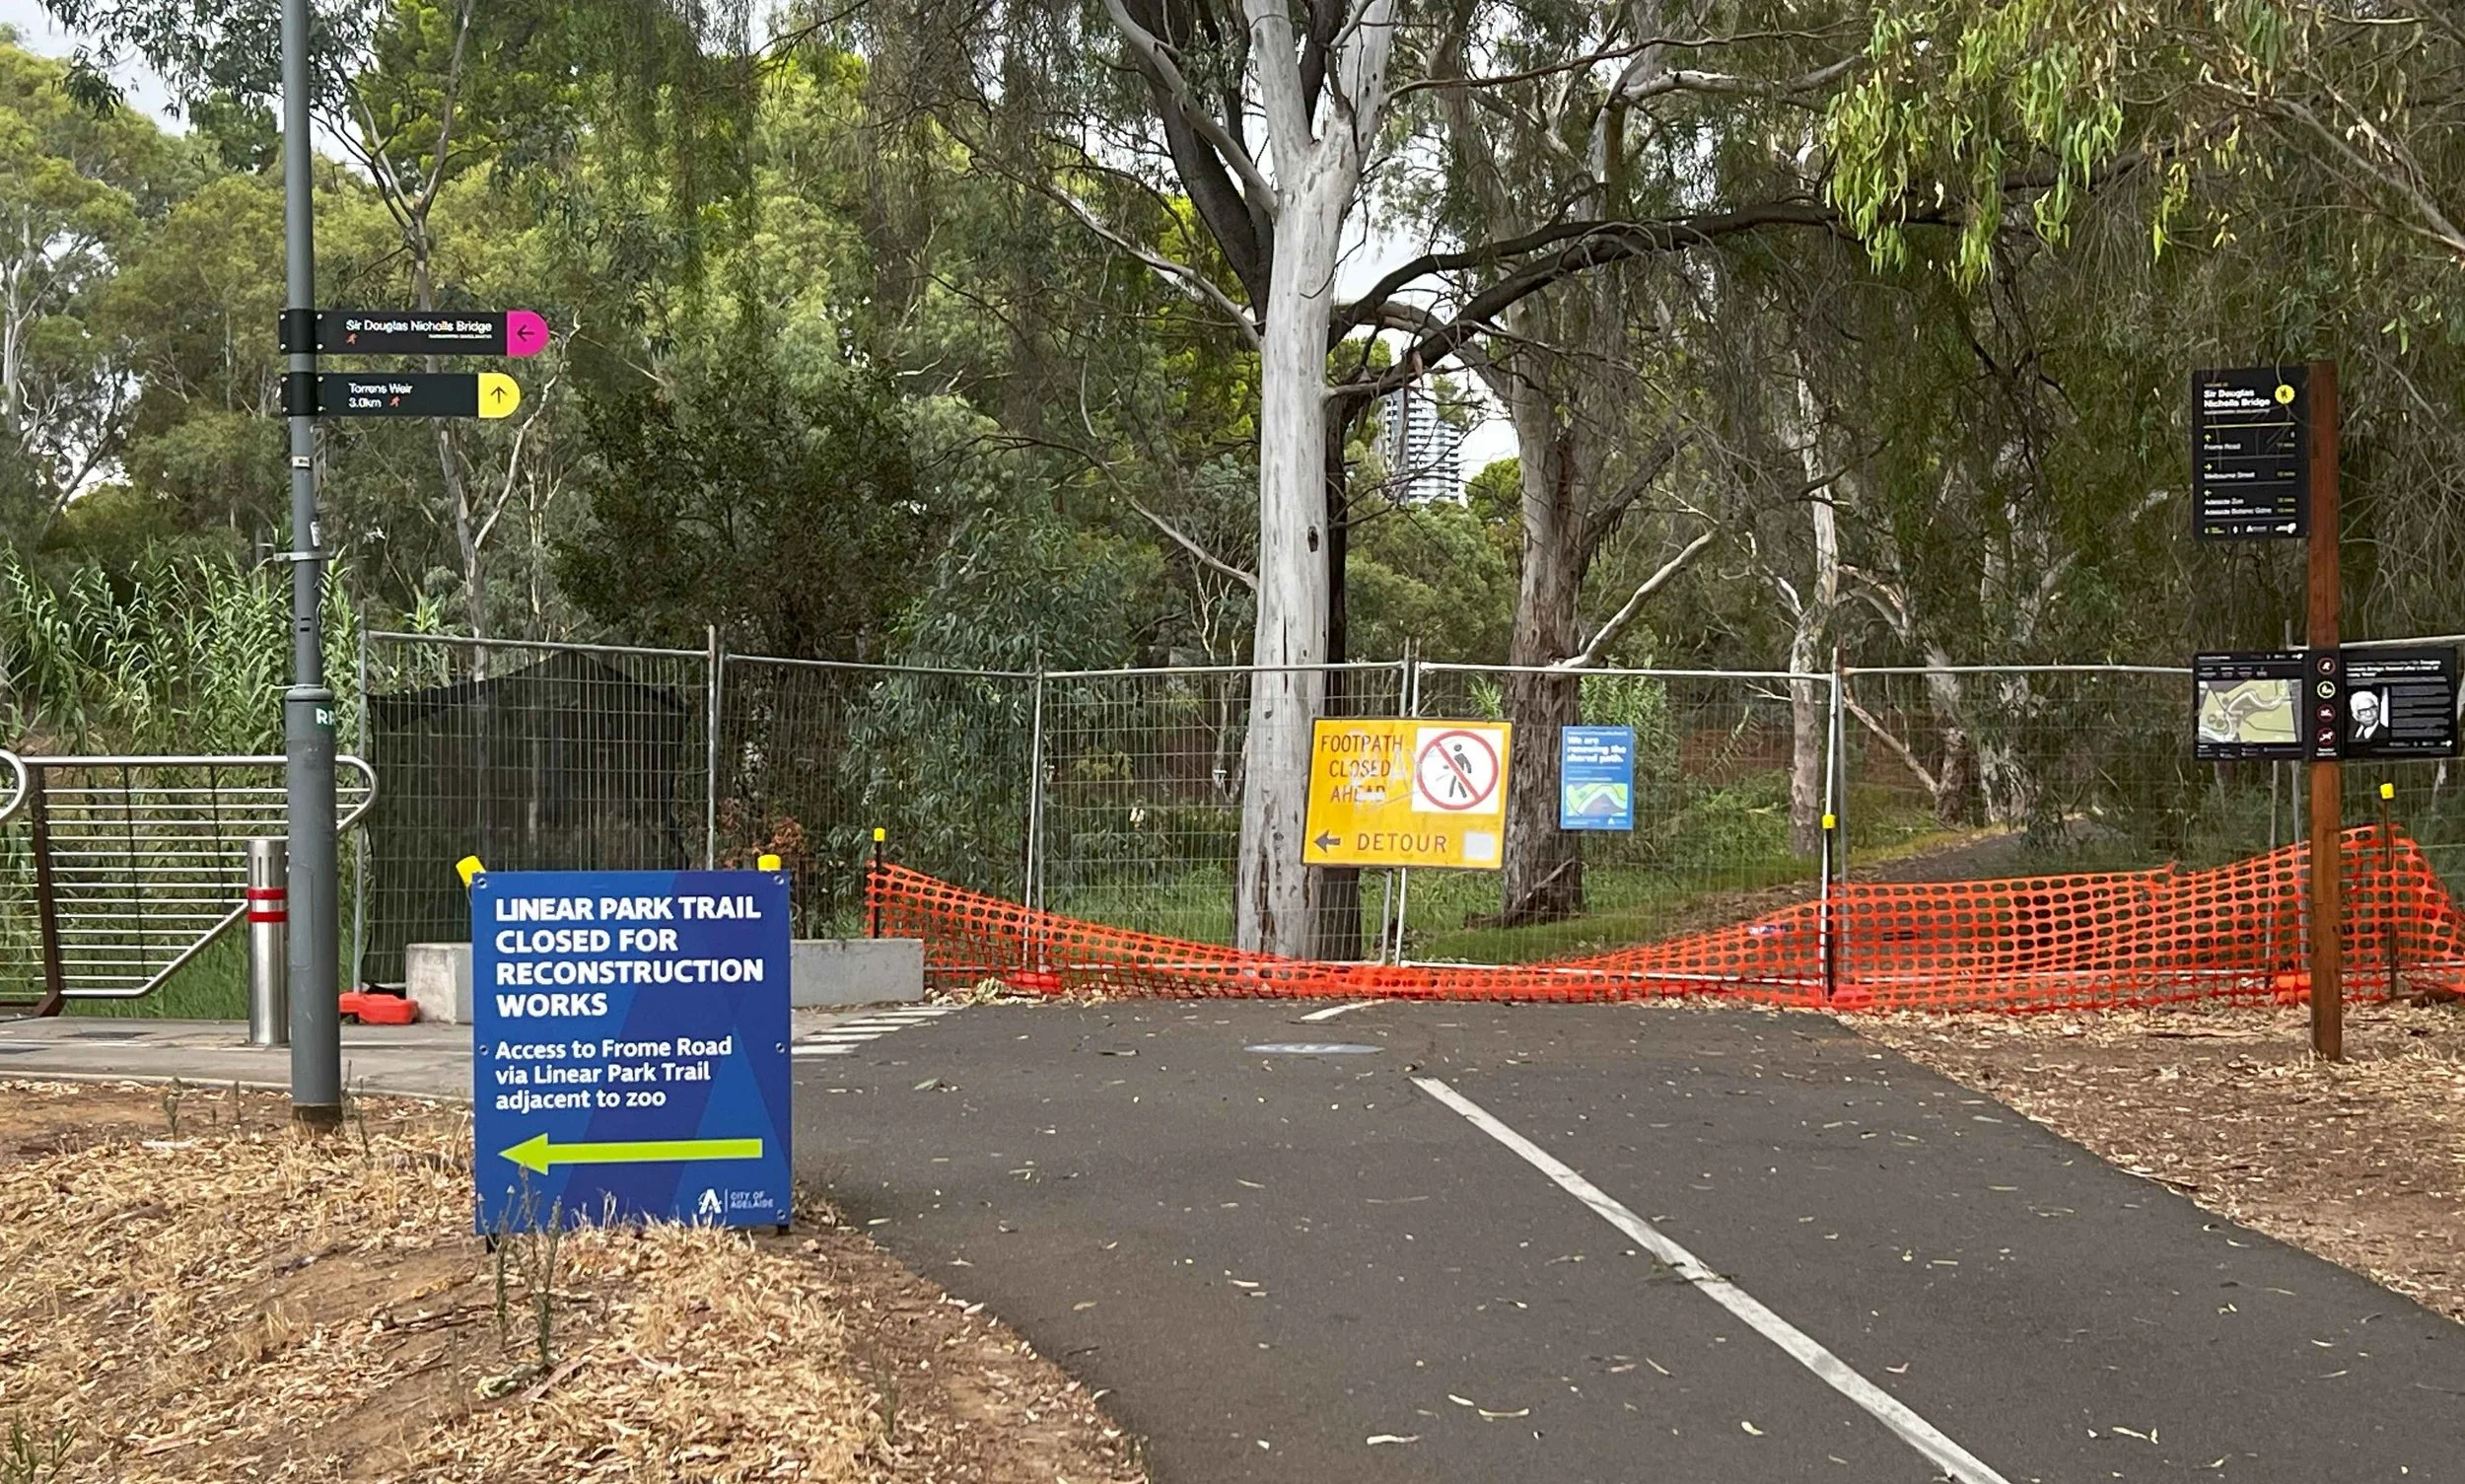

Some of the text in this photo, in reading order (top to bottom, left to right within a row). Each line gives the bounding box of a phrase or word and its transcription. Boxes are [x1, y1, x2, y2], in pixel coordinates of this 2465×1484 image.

[345, 319, 493, 334] Sir Douglas Nicholls Bridge
[348, 382, 413, 394] Torrens Weir
[2240, 397, 2271, 407] Bridge
[1320, 734, 1404, 753] FOOTPATH
[1328, 759, 1391, 778] CLOSED
[1357, 832, 1447, 853] DETOUR
[495, 895, 762, 922] LINEAR PARK TRAIL
[495, 928, 679, 954] CLOSED FOR
[495, 958, 764, 985] RECONSTRUCTION
[495, 992, 608, 1018] WORKS
[495, 1035, 733, 1060] Access to Frome Road
[495, 1061, 711, 1085] via Linear Park Trail
[495, 1090, 667, 1114] adjacent to zoo
[730, 1190, 765, 1200] CITY OF
[730, 1198, 774, 1209] ADELAIDE
